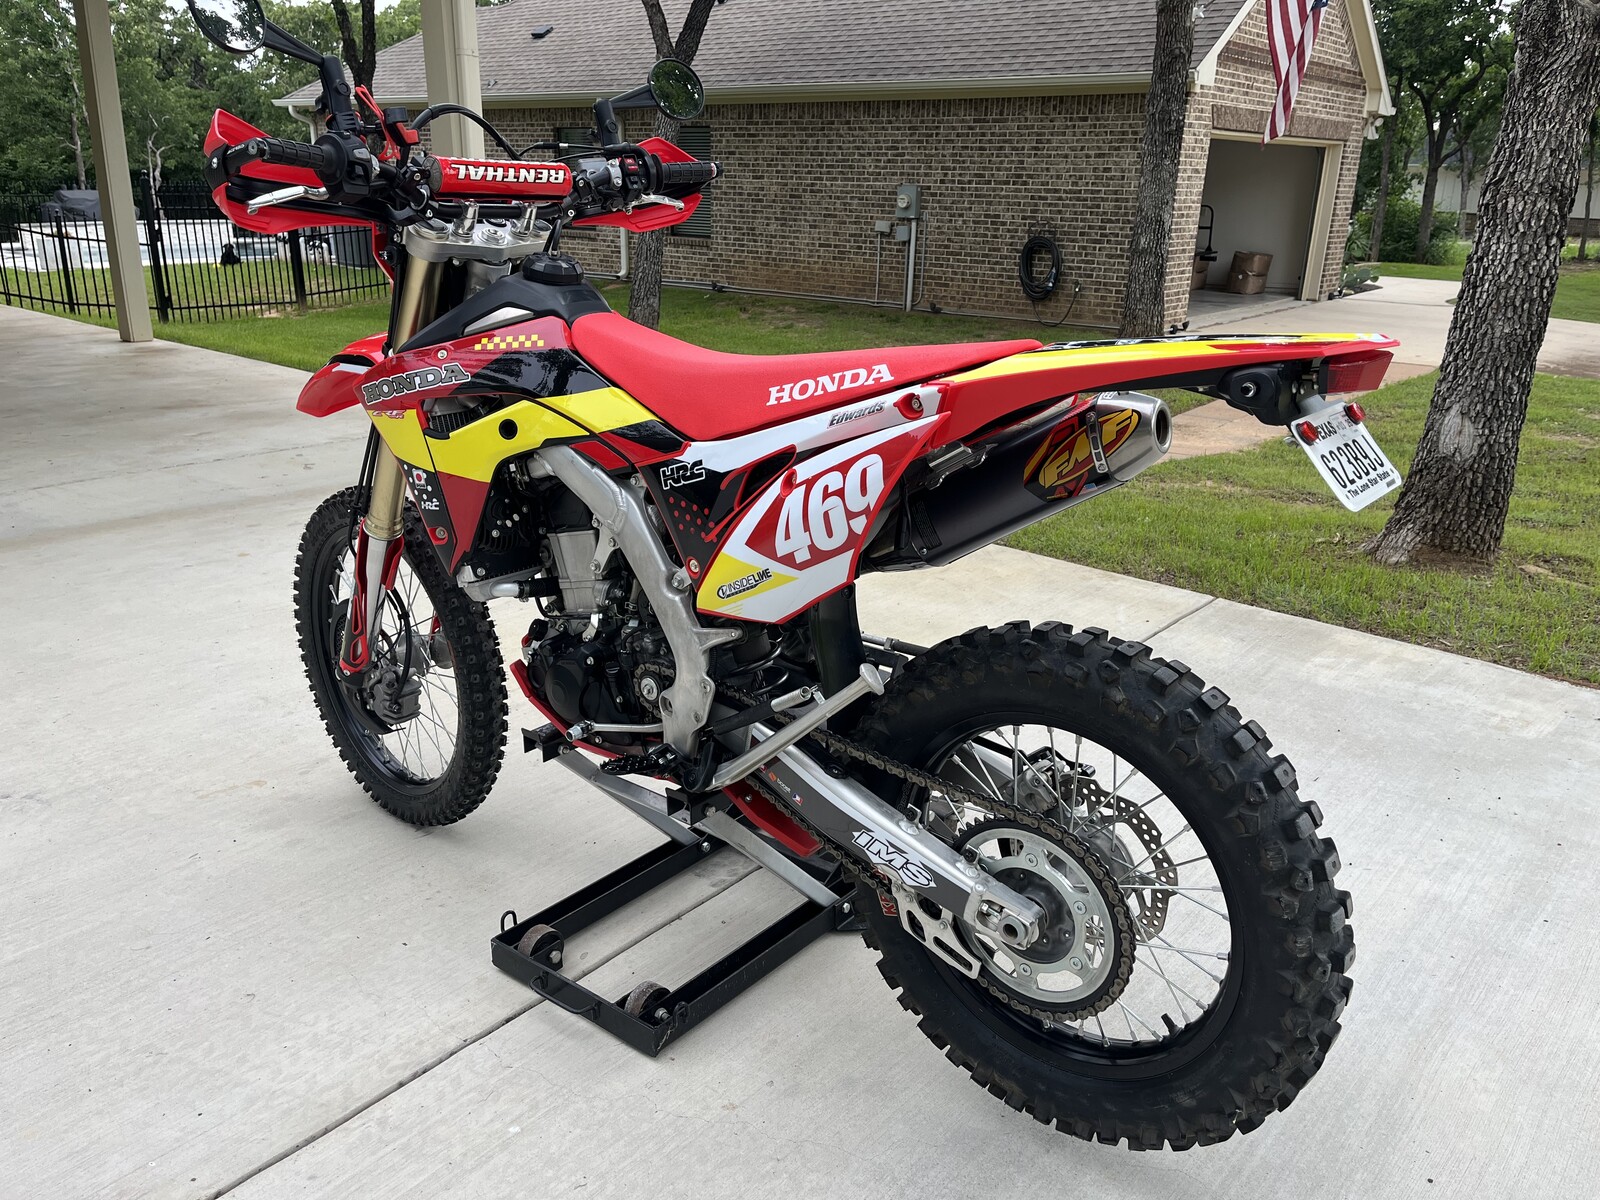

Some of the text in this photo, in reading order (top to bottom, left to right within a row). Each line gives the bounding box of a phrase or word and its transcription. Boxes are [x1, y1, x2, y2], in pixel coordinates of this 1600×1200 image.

[450, 163, 566, 184] RENTHAL
[362, 363, 471, 405] HONDA
[766, 364, 895, 406] HONDA
[828, 401, 886, 428] Edwards
[660, 459, 706, 490] HRC
[1320, 434, 1385, 489] 623B9J
[1347, 470, 1391, 498] The Lone Star State
[421, 501, 440, 510] HRC
[775, 453, 885, 564] 469
[854, 830, 933, 887] IMS
